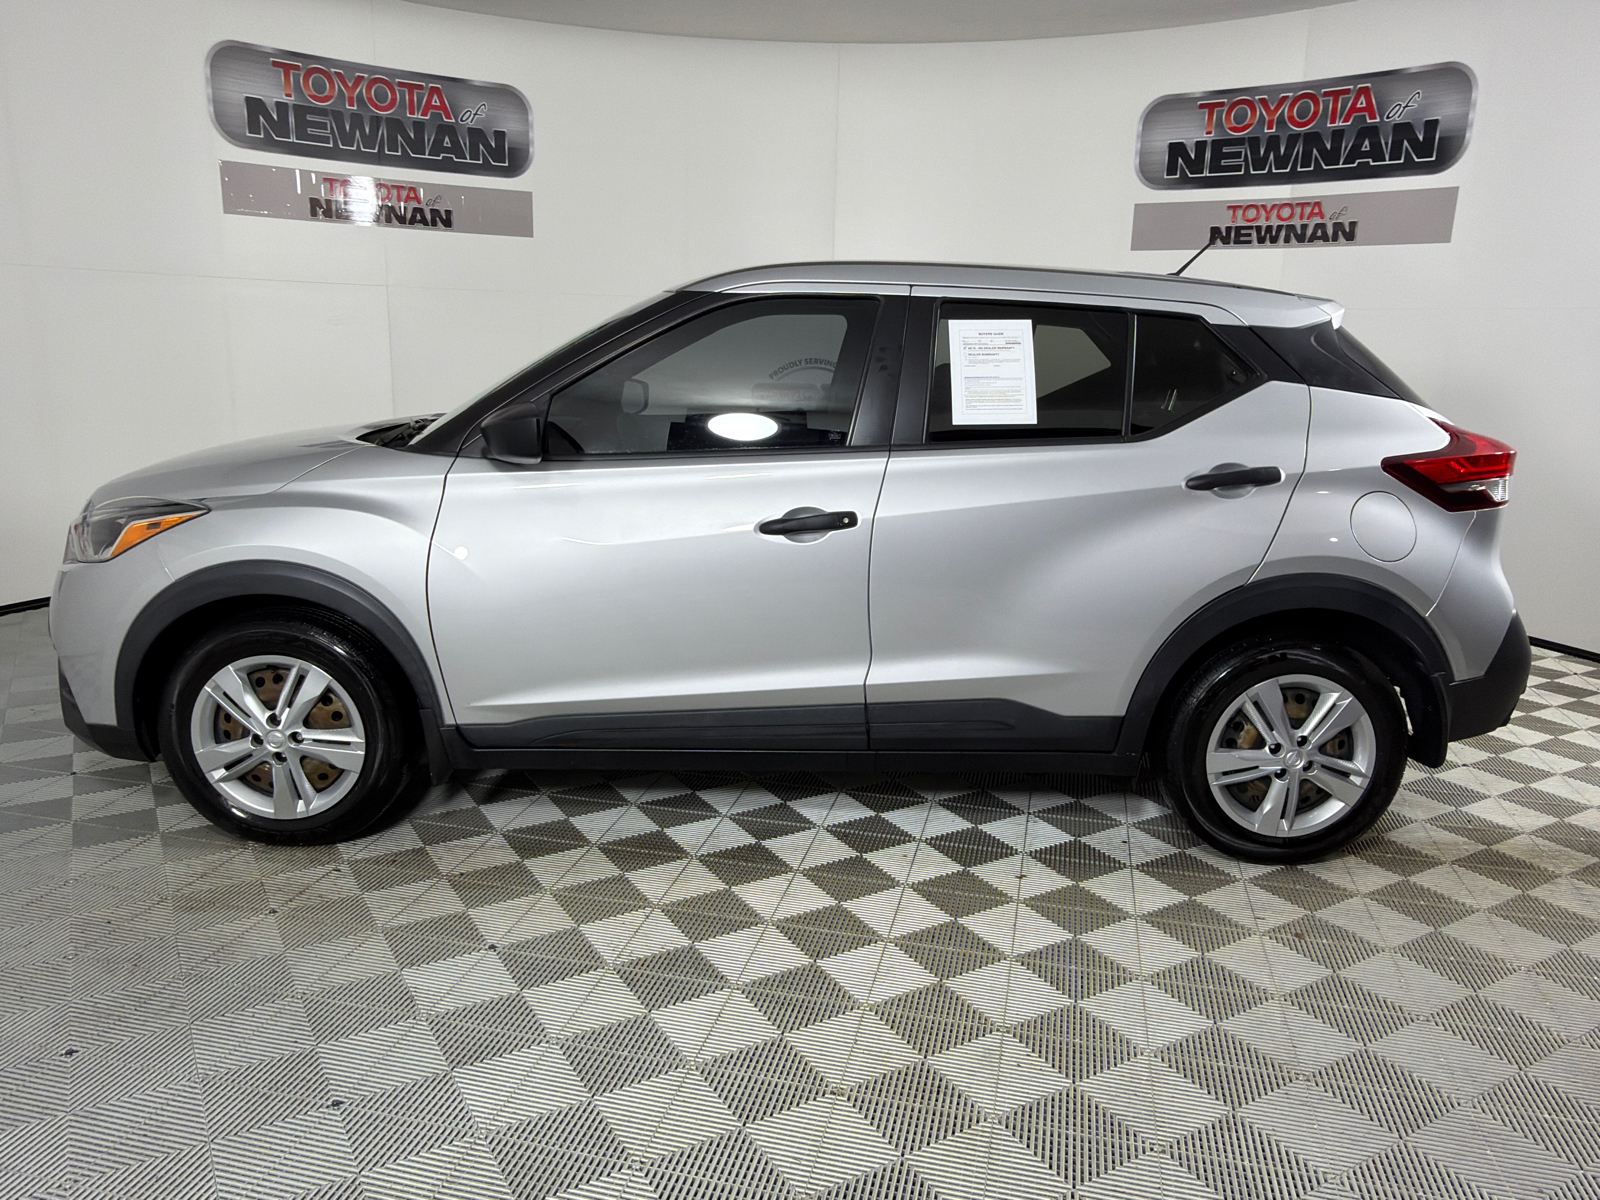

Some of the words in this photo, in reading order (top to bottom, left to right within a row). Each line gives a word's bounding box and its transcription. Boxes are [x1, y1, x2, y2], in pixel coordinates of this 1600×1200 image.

[271, 59, 454, 121] TOYOTA
[459, 103, 487, 124] of
[1198, 84, 1380, 136] TOYOTA
[1384, 90, 1421, 122] of
[244, 95, 508, 166] NEWNAN
[1164, 117, 1441, 179] NEWNAN
[323, 177, 422, 205] TOOTA
[425, 195, 442, 207] of
[309, 197, 453, 228] NNAN
[1227, 201, 1325, 223] TOYOTA
[1329, 206, 1348, 220] of
[1210, 221, 1358, 245] NEWNAN
[769, 359, 803, 380] PROUDLY
